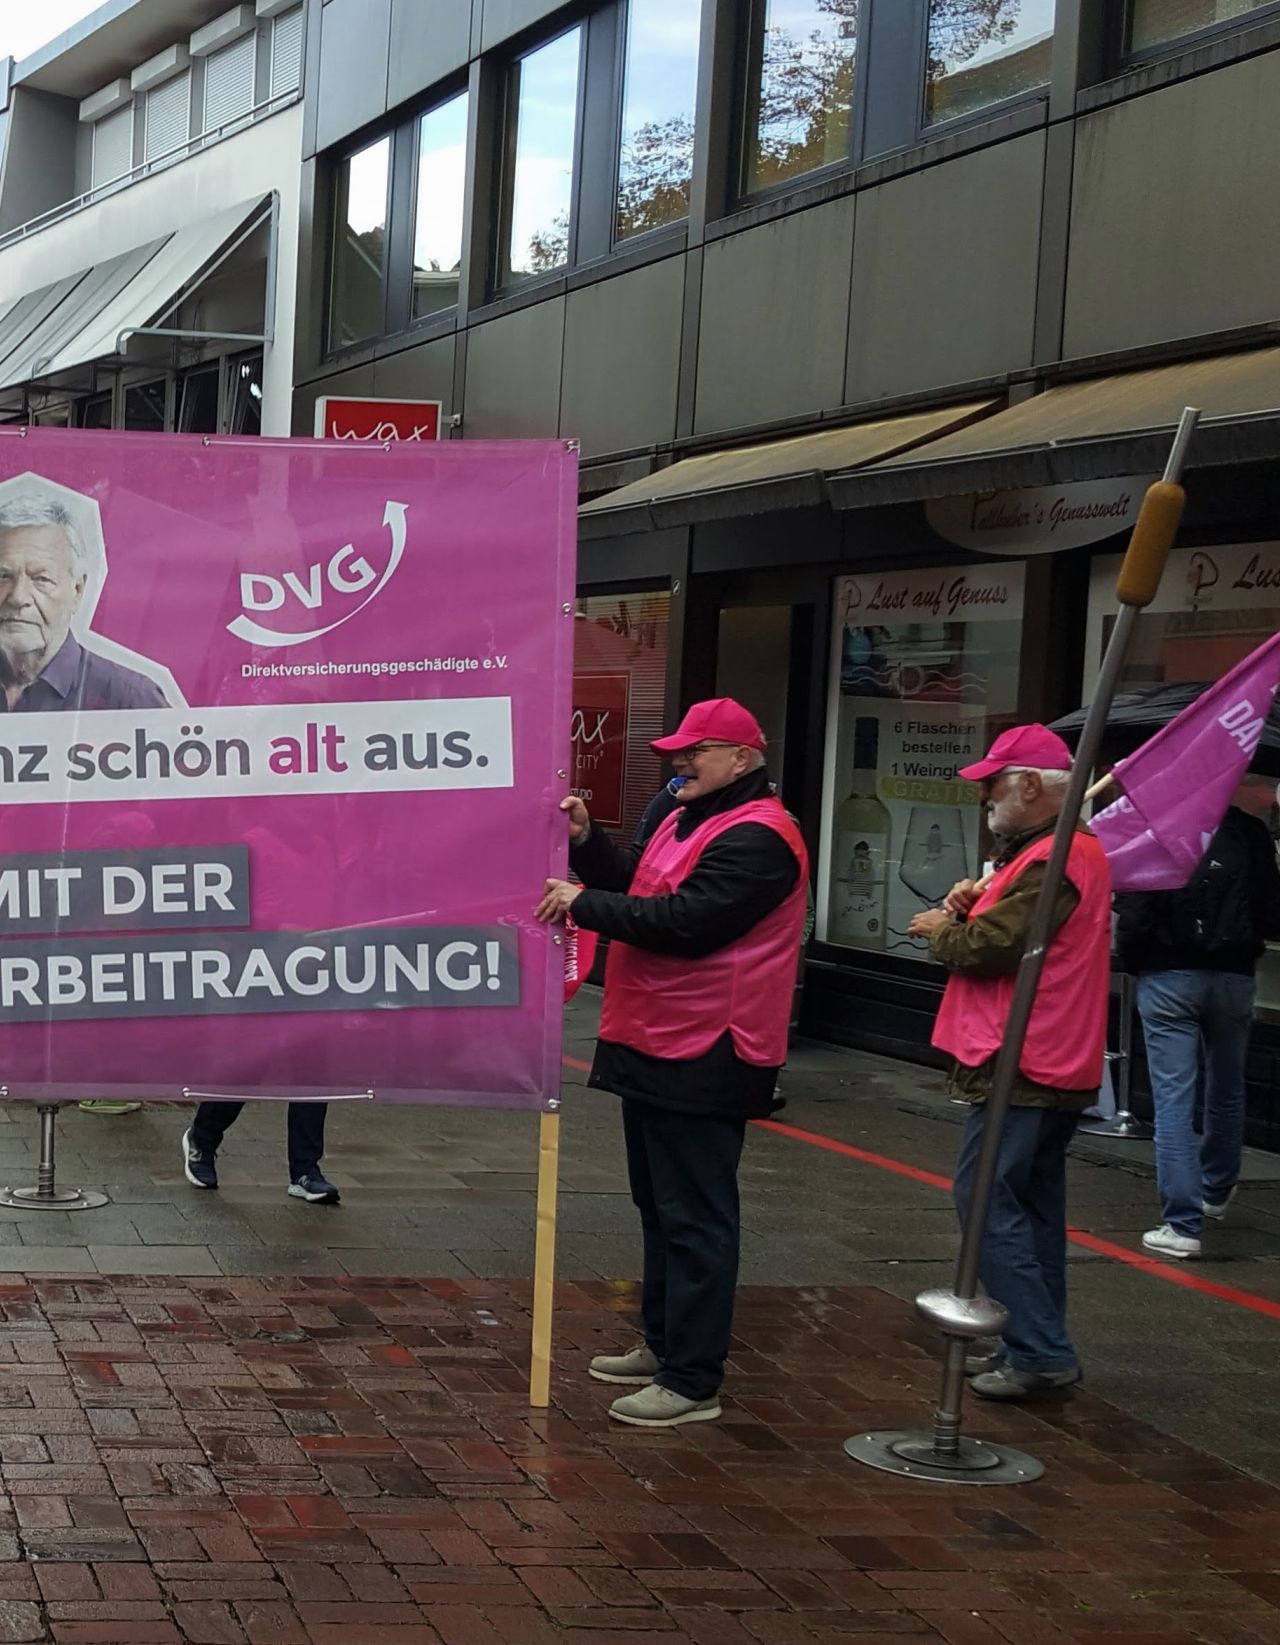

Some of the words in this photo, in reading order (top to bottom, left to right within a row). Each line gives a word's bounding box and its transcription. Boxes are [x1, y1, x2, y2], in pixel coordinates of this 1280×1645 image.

[331, 420, 429, 441] wax
[1049, 493, 1131, 532] Genusswelt
[240, 543, 377, 612] DVG
[865, 581, 909, 611] Lust
[911, 580, 946, 616] auf
[946, 575, 1009, 616] Genuss
[240, 657, 479, 678] Direktversicherungsgeschädigte
[482, 655, 509, 670] e.V.
[570, 709, 610, 745] ax
[894, 721, 903, 734] 6
[907, 721, 976, 735] Flaschen
[65, 725, 252, 783] schön
[267, 722, 349, 775] alt
[363, 729, 490, 772] aus.
[901, 740, 972, 754] bestellen
[575, 754, 600, 769] CITY
[891, 762, 898, 776] 1
[903, 762, 959, 781] Weingl
[894, 779, 977, 802] GRATIS
[101, 861, 236, 916] DER
